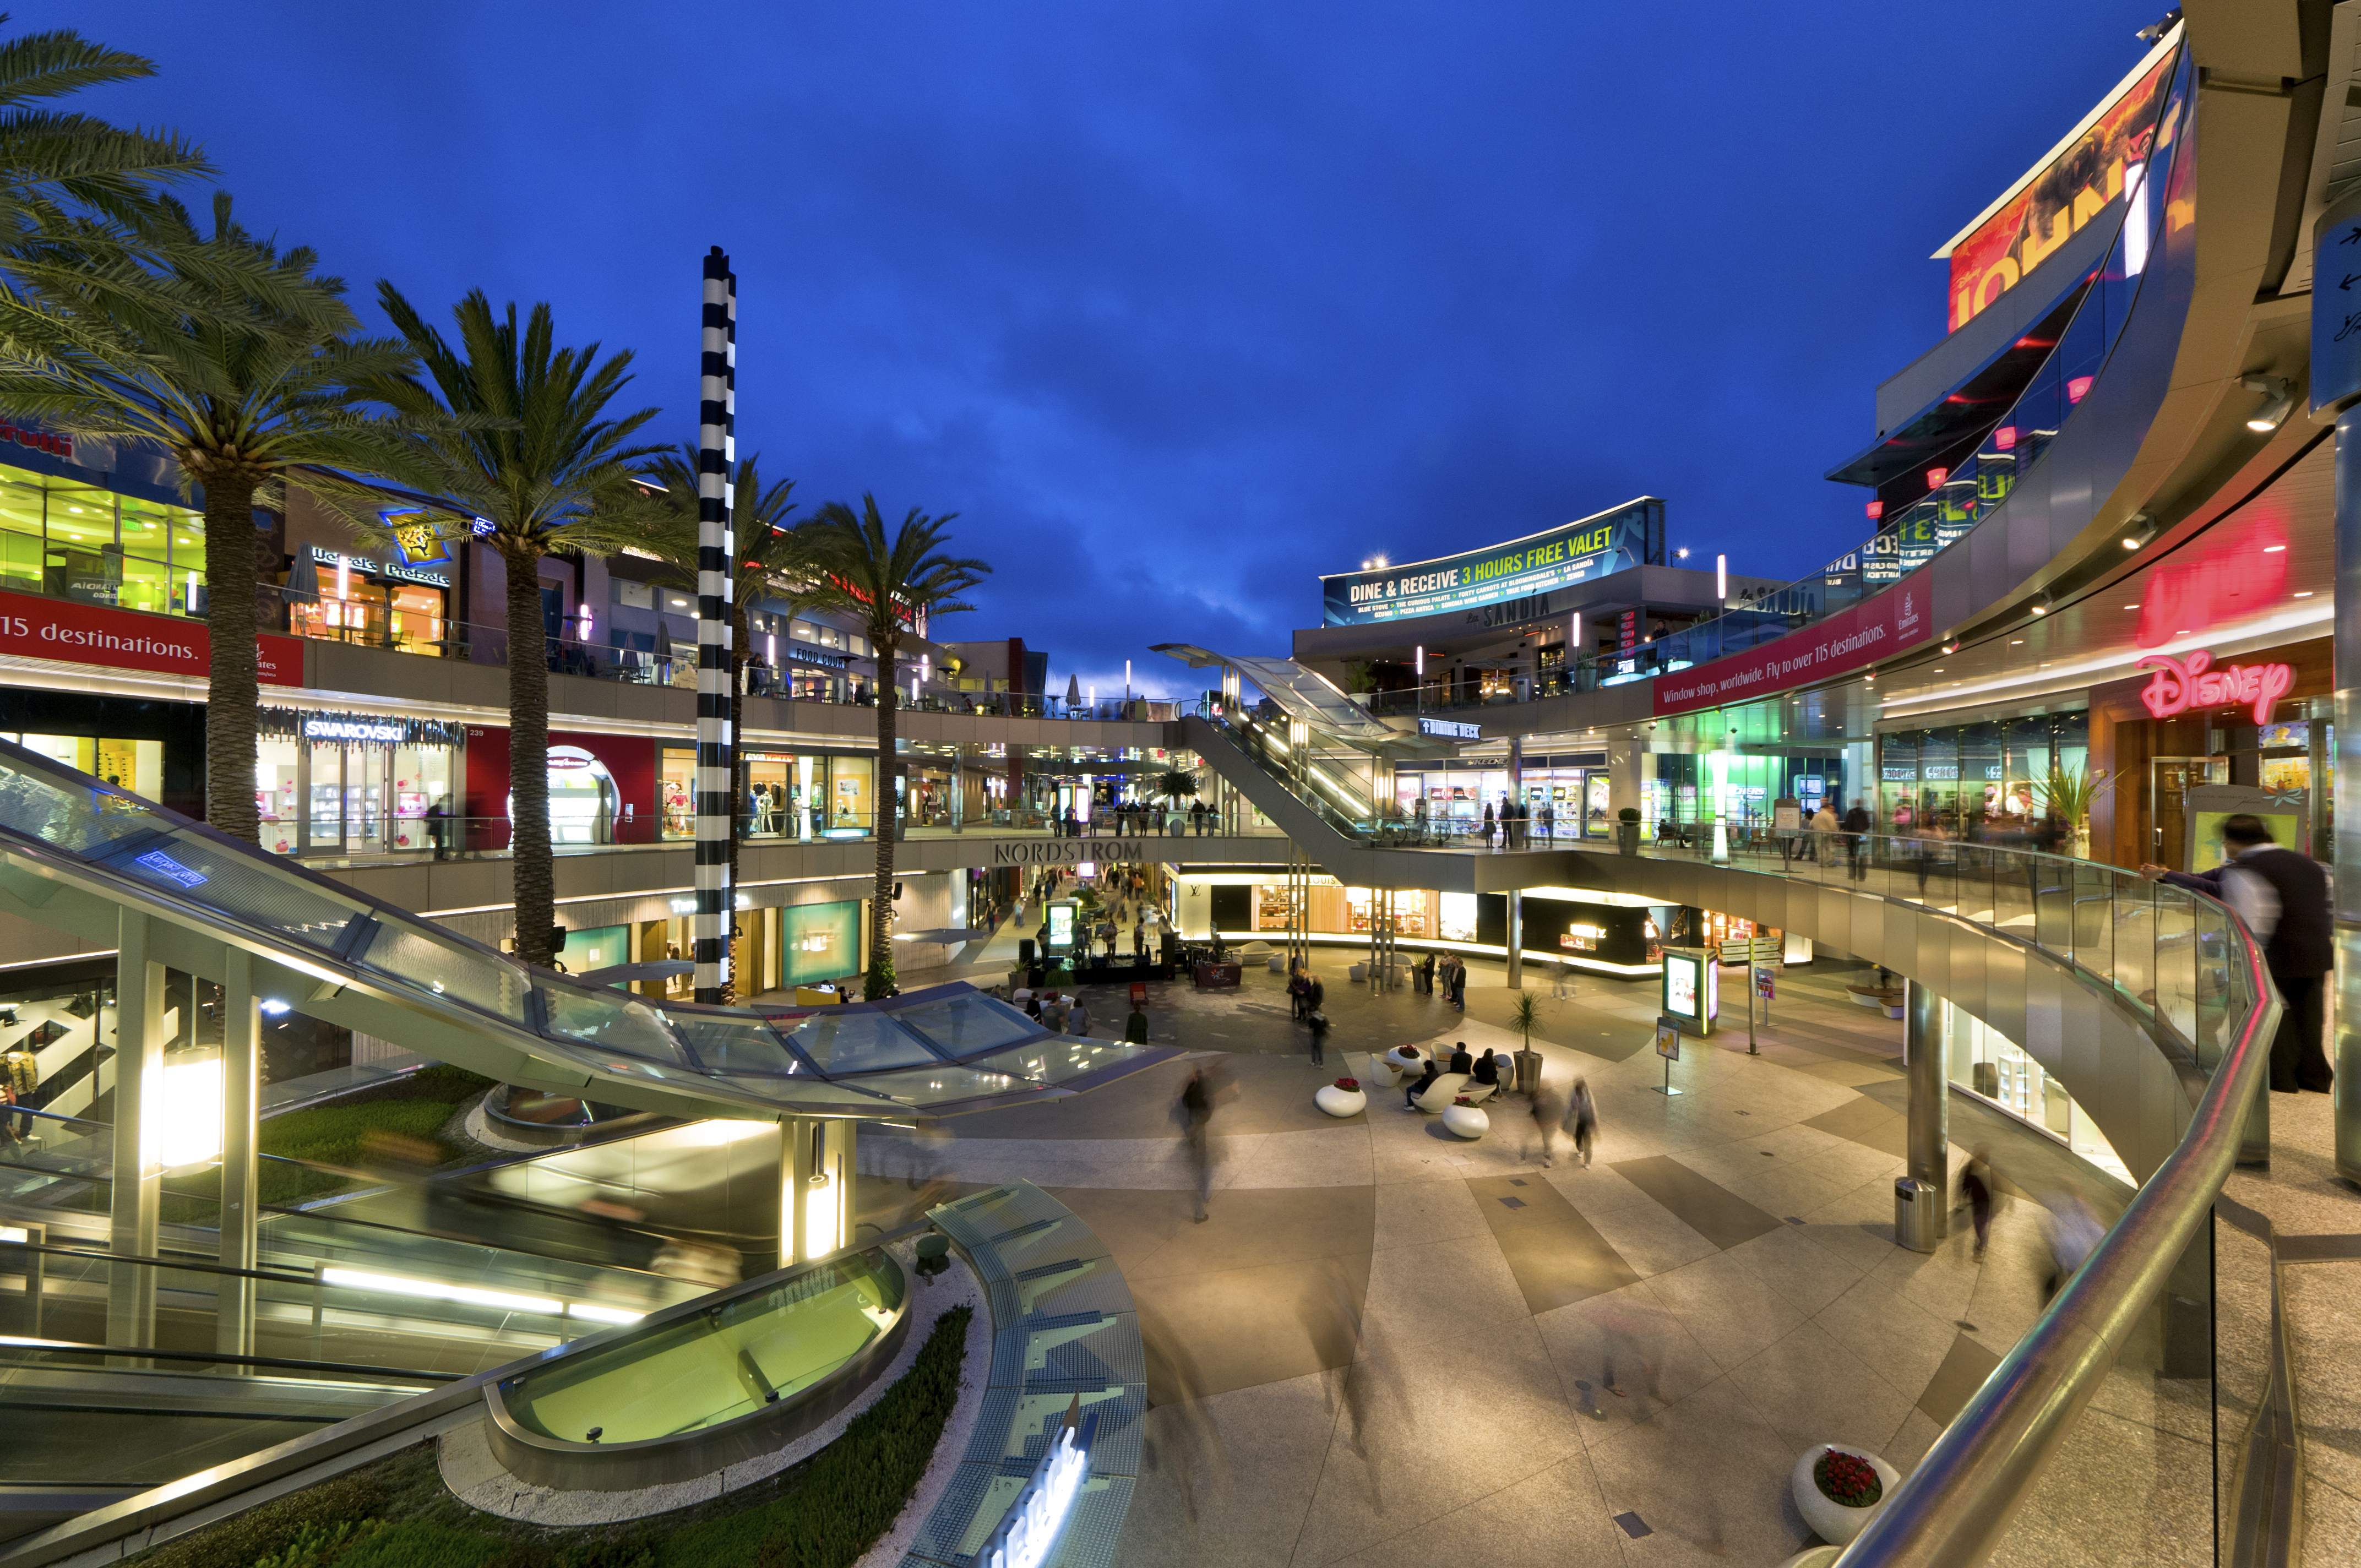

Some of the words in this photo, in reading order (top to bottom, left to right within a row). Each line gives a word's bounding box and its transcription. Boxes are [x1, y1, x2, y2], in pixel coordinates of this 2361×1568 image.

[0, 418, 72, 457] rutti
[388, 564, 450, 586] Pretzels
[1351, 582, 1383, 602] DINE
[1386, 580, 1396, 597] &
[1400, 569, 1459, 595] RECEIVE
[1462, 567, 1471, 584] 3
[1475, 553, 1522, 581] HOURS
[1526, 541, 1564, 568] FREE
[1568, 526, 1612, 557] VALET
[1407, 598, 1430, 606] CURIOUS
[1432, 594, 1450, 603] PALATE
[1458, 589, 1475, 597] FORTY
[1476, 584, 1500, 595] CARROTS
[1509, 569, 1555, 586] BLOOMINGDALE'S
[1564, 564, 1571, 573] LA
[1441, 600, 1463, 609] SONOMA
[1465, 596, 1478, 605] WINE
[1478, 592, 1499, 601] GARDEN
[1536, 578, 1559, 589] KITCHEN
[1566, 570, 1585, 581] ZENGO
[40, 623, 199, 660] destinations.
[796, 647, 819, 663] FOOD
[823, 654, 846, 669] COUR
[1663, 686, 1694, 703] Window
[1696, 682, 1719, 698] shop,
[1720, 669, 1765, 691] worldwide.
[1767, 662, 1780, 680] Fly
[1782, 661, 1791, 673] to
[1793, 652, 1813, 670] over
[1815, 645, 1828, 663] 115
[1831, 624, 1886, 657] destinations.
[307, 721, 402, 741] SWAROVSKI
[1430, 721, 1458, 737] DINING
[1459, 725, 1479, 739] DECK
[995, 841, 1143, 864] NORDSTROM
